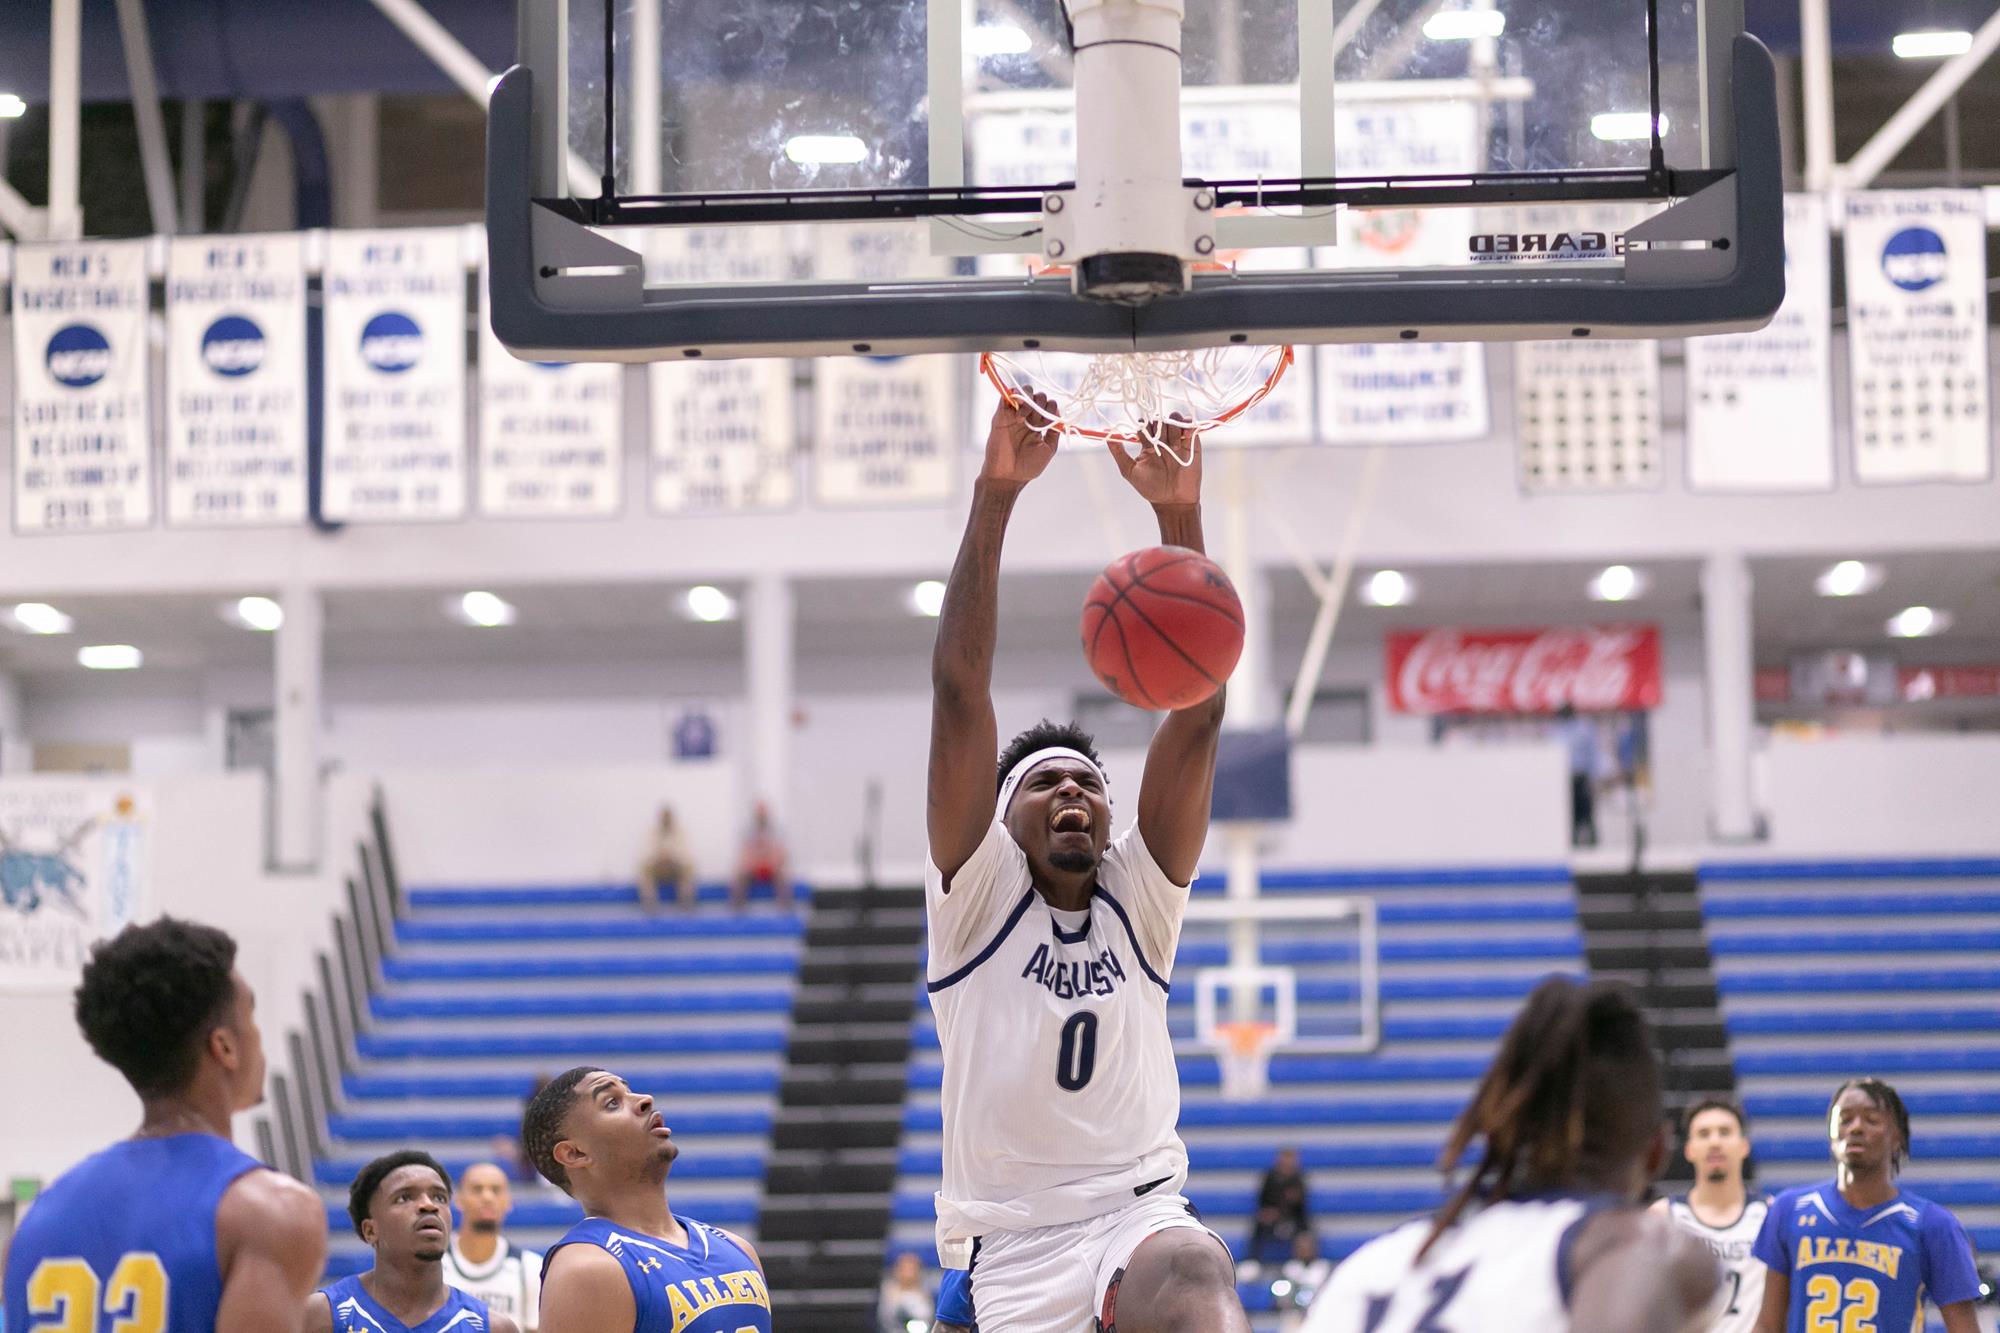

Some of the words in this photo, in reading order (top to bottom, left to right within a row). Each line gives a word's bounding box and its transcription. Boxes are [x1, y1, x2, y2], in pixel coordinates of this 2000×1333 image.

[1055, 1009, 1100, 1094] 0
[1795, 1236, 1903, 1280] ALLEN
[664, 1269, 772, 1333] ALLEN
[1806, 1273, 1881, 1333] 22
